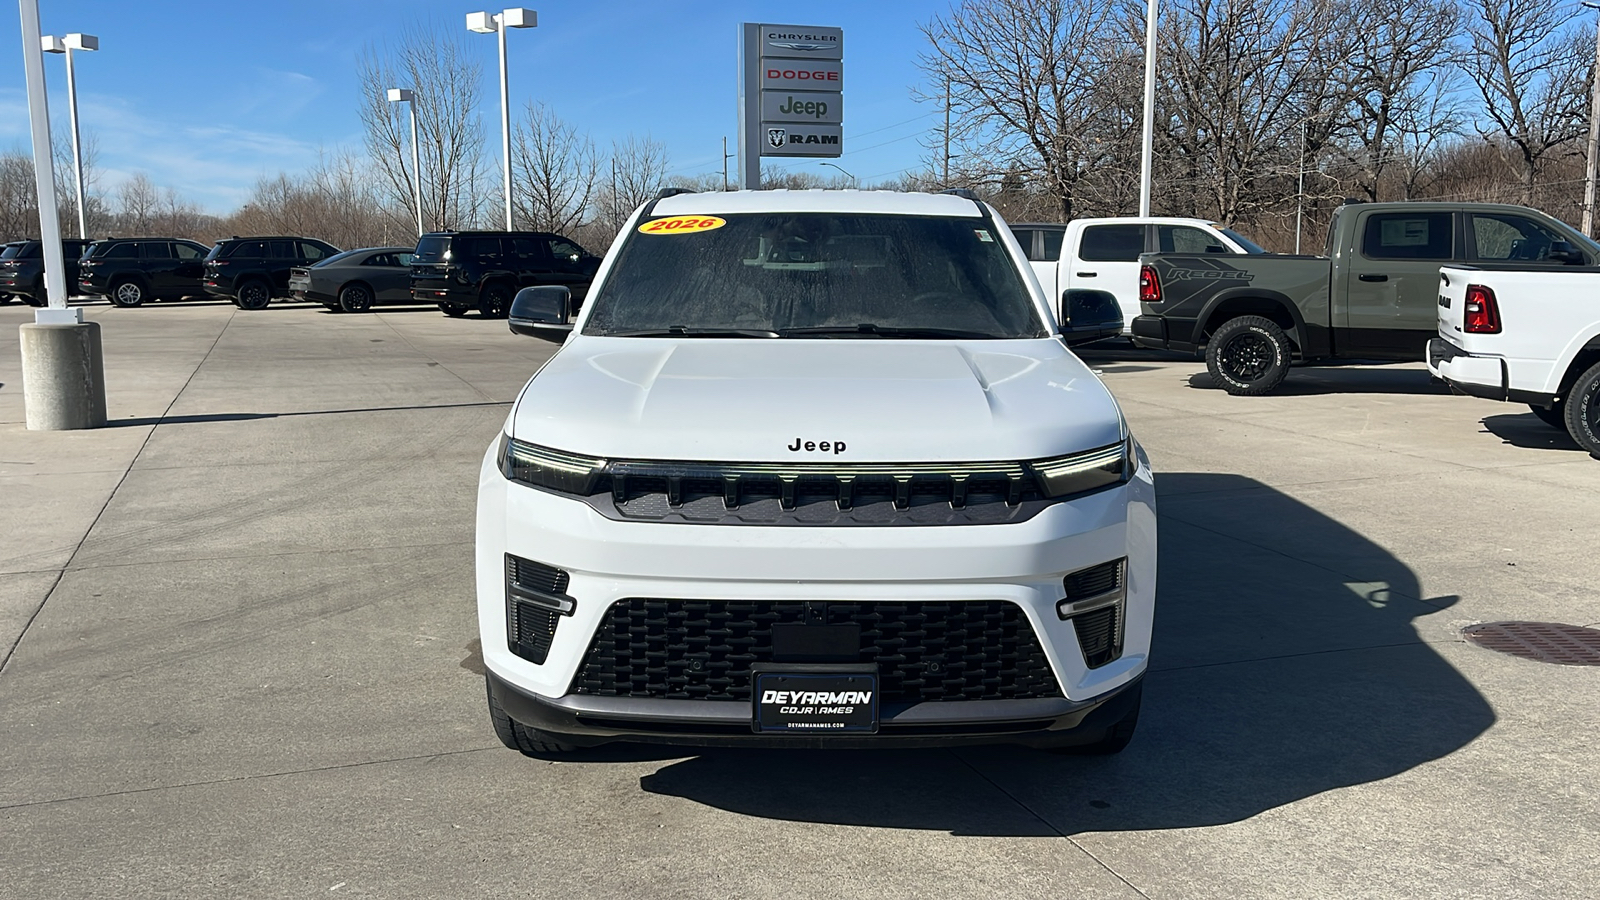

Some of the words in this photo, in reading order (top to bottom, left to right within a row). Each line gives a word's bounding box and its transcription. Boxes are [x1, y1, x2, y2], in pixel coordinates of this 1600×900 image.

[768, 33, 837, 41] CHRYSLER
[767, 69, 838, 80] DODGE
[779, 96, 828, 118] Jeep
[789, 134, 838, 144] RAM
[646, 218, 717, 231] 2026
[1166, 267, 1255, 281] REBEL
[787, 437, 847, 455] Jeep
[761, 690, 872, 704] DEYARMAN
